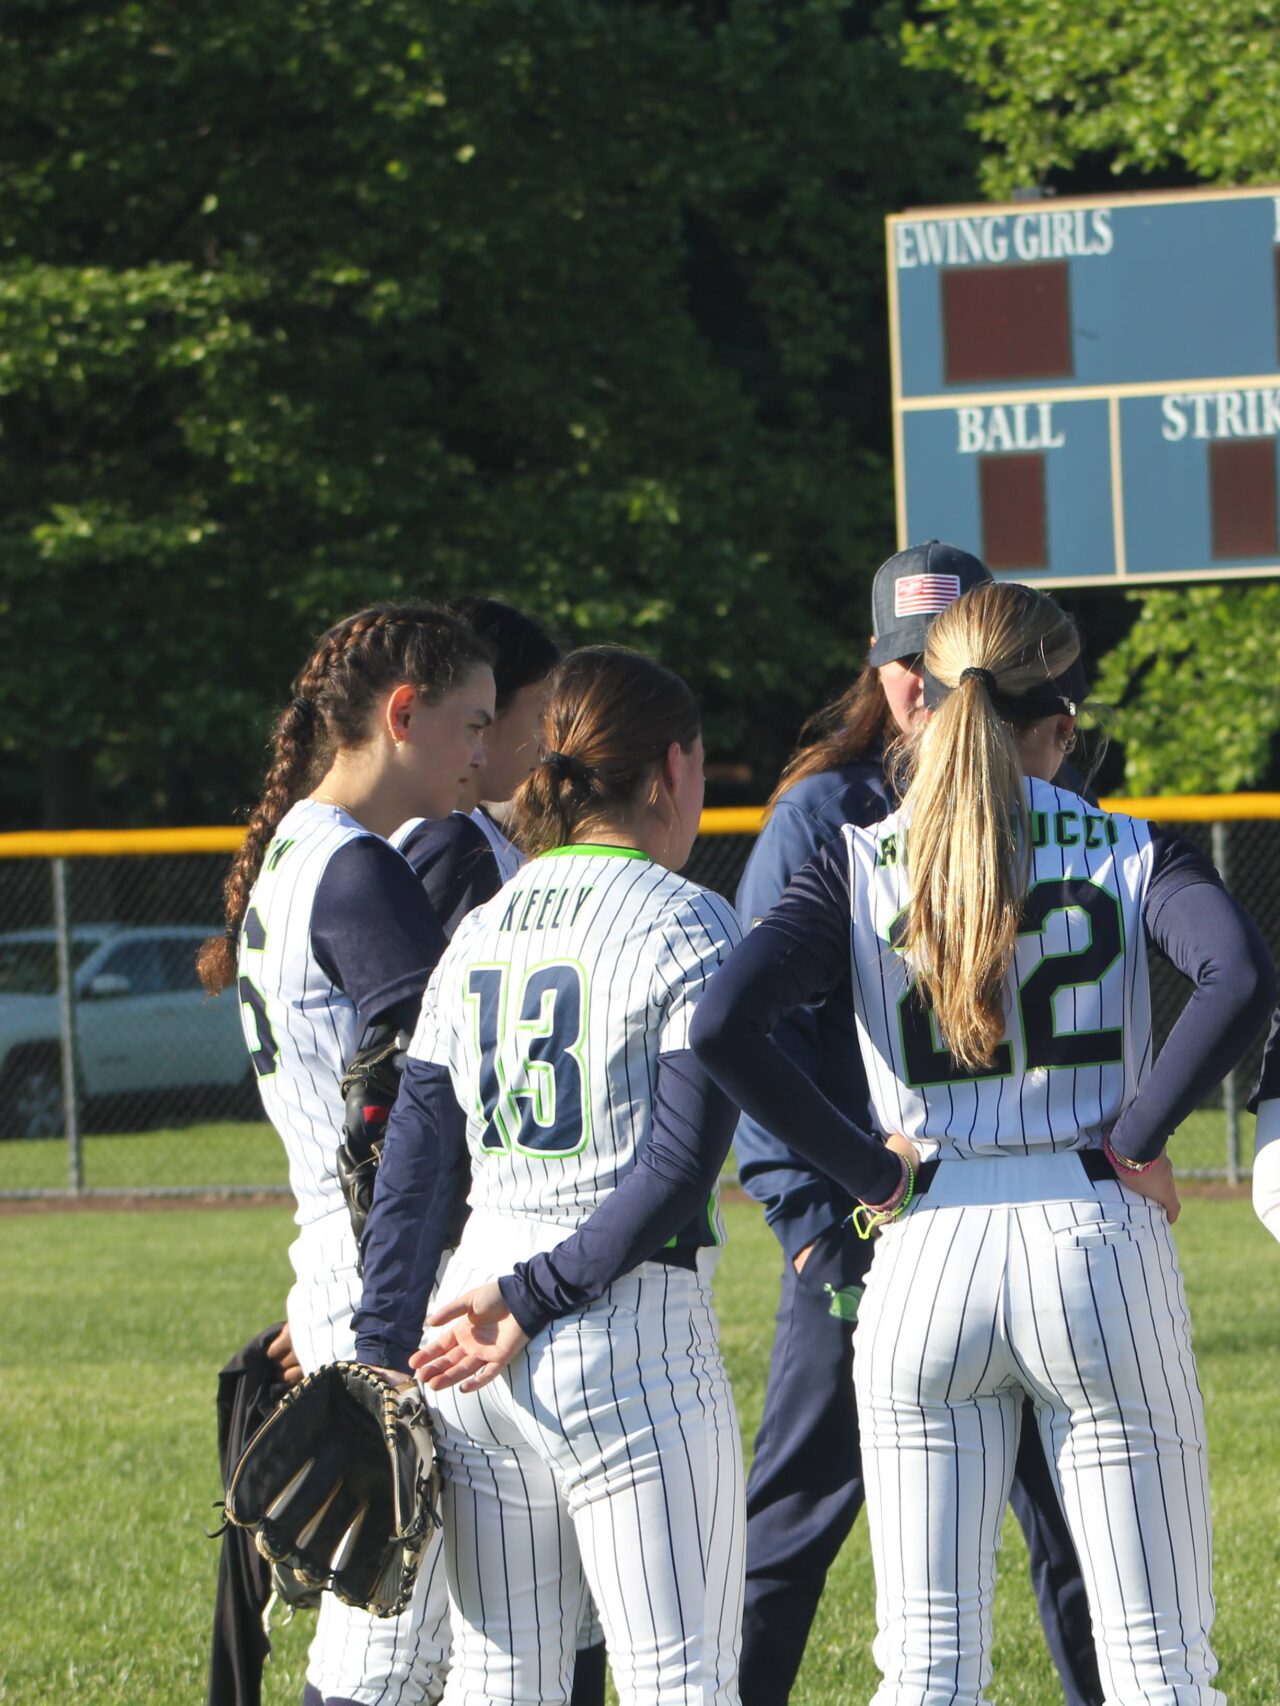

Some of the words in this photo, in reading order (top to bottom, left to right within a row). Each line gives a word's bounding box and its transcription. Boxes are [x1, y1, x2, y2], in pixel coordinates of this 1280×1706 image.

[896, 217, 1008, 269] EWING
[1014, 208, 1114, 261] GIRLS
[956, 402, 1065, 454] BALL
[500, 884, 596, 932] KEELY
[464, 958, 592, 1159] 13
